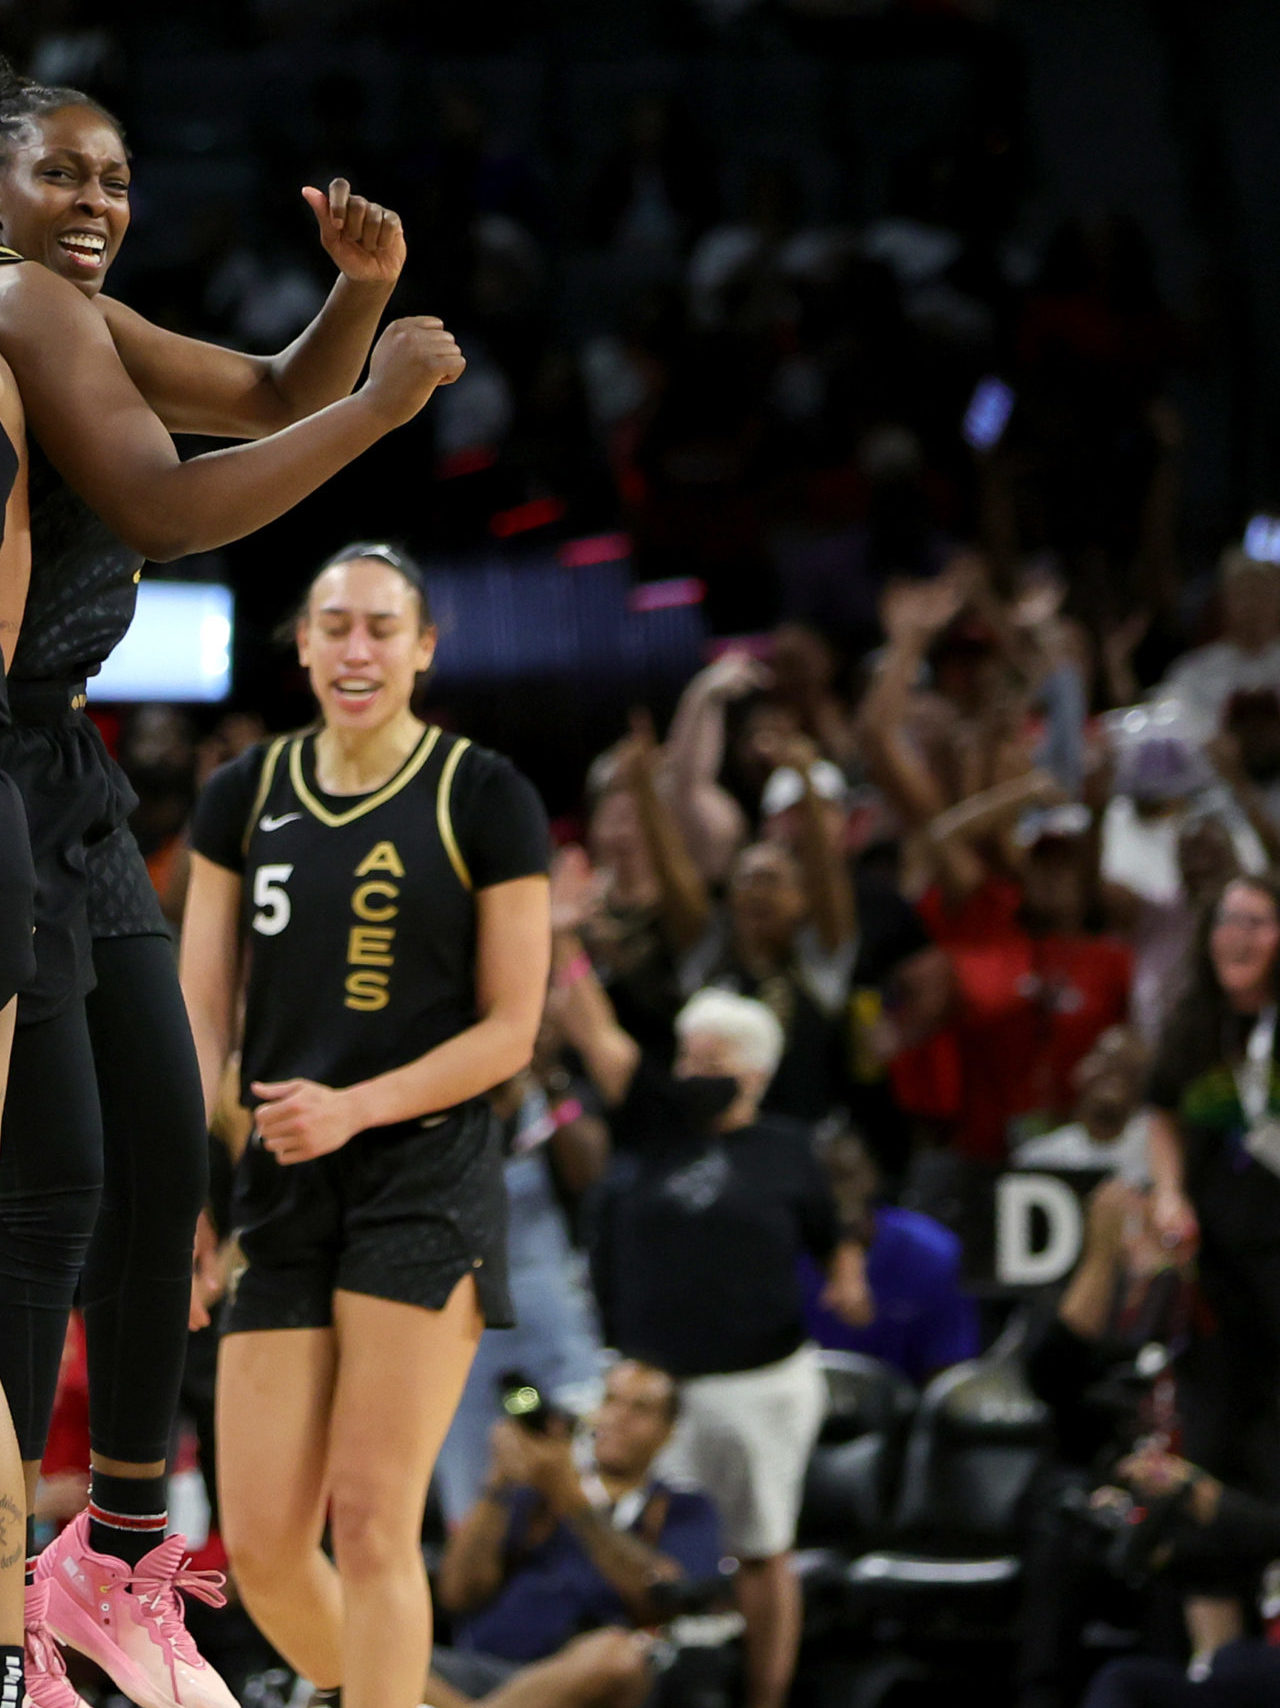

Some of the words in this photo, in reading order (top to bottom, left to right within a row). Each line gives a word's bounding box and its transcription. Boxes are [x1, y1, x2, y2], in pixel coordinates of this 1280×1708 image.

[252, 863, 295, 936] 5
[344, 840, 406, 1012] ACES
[995, 1172, 1084, 1287] D
